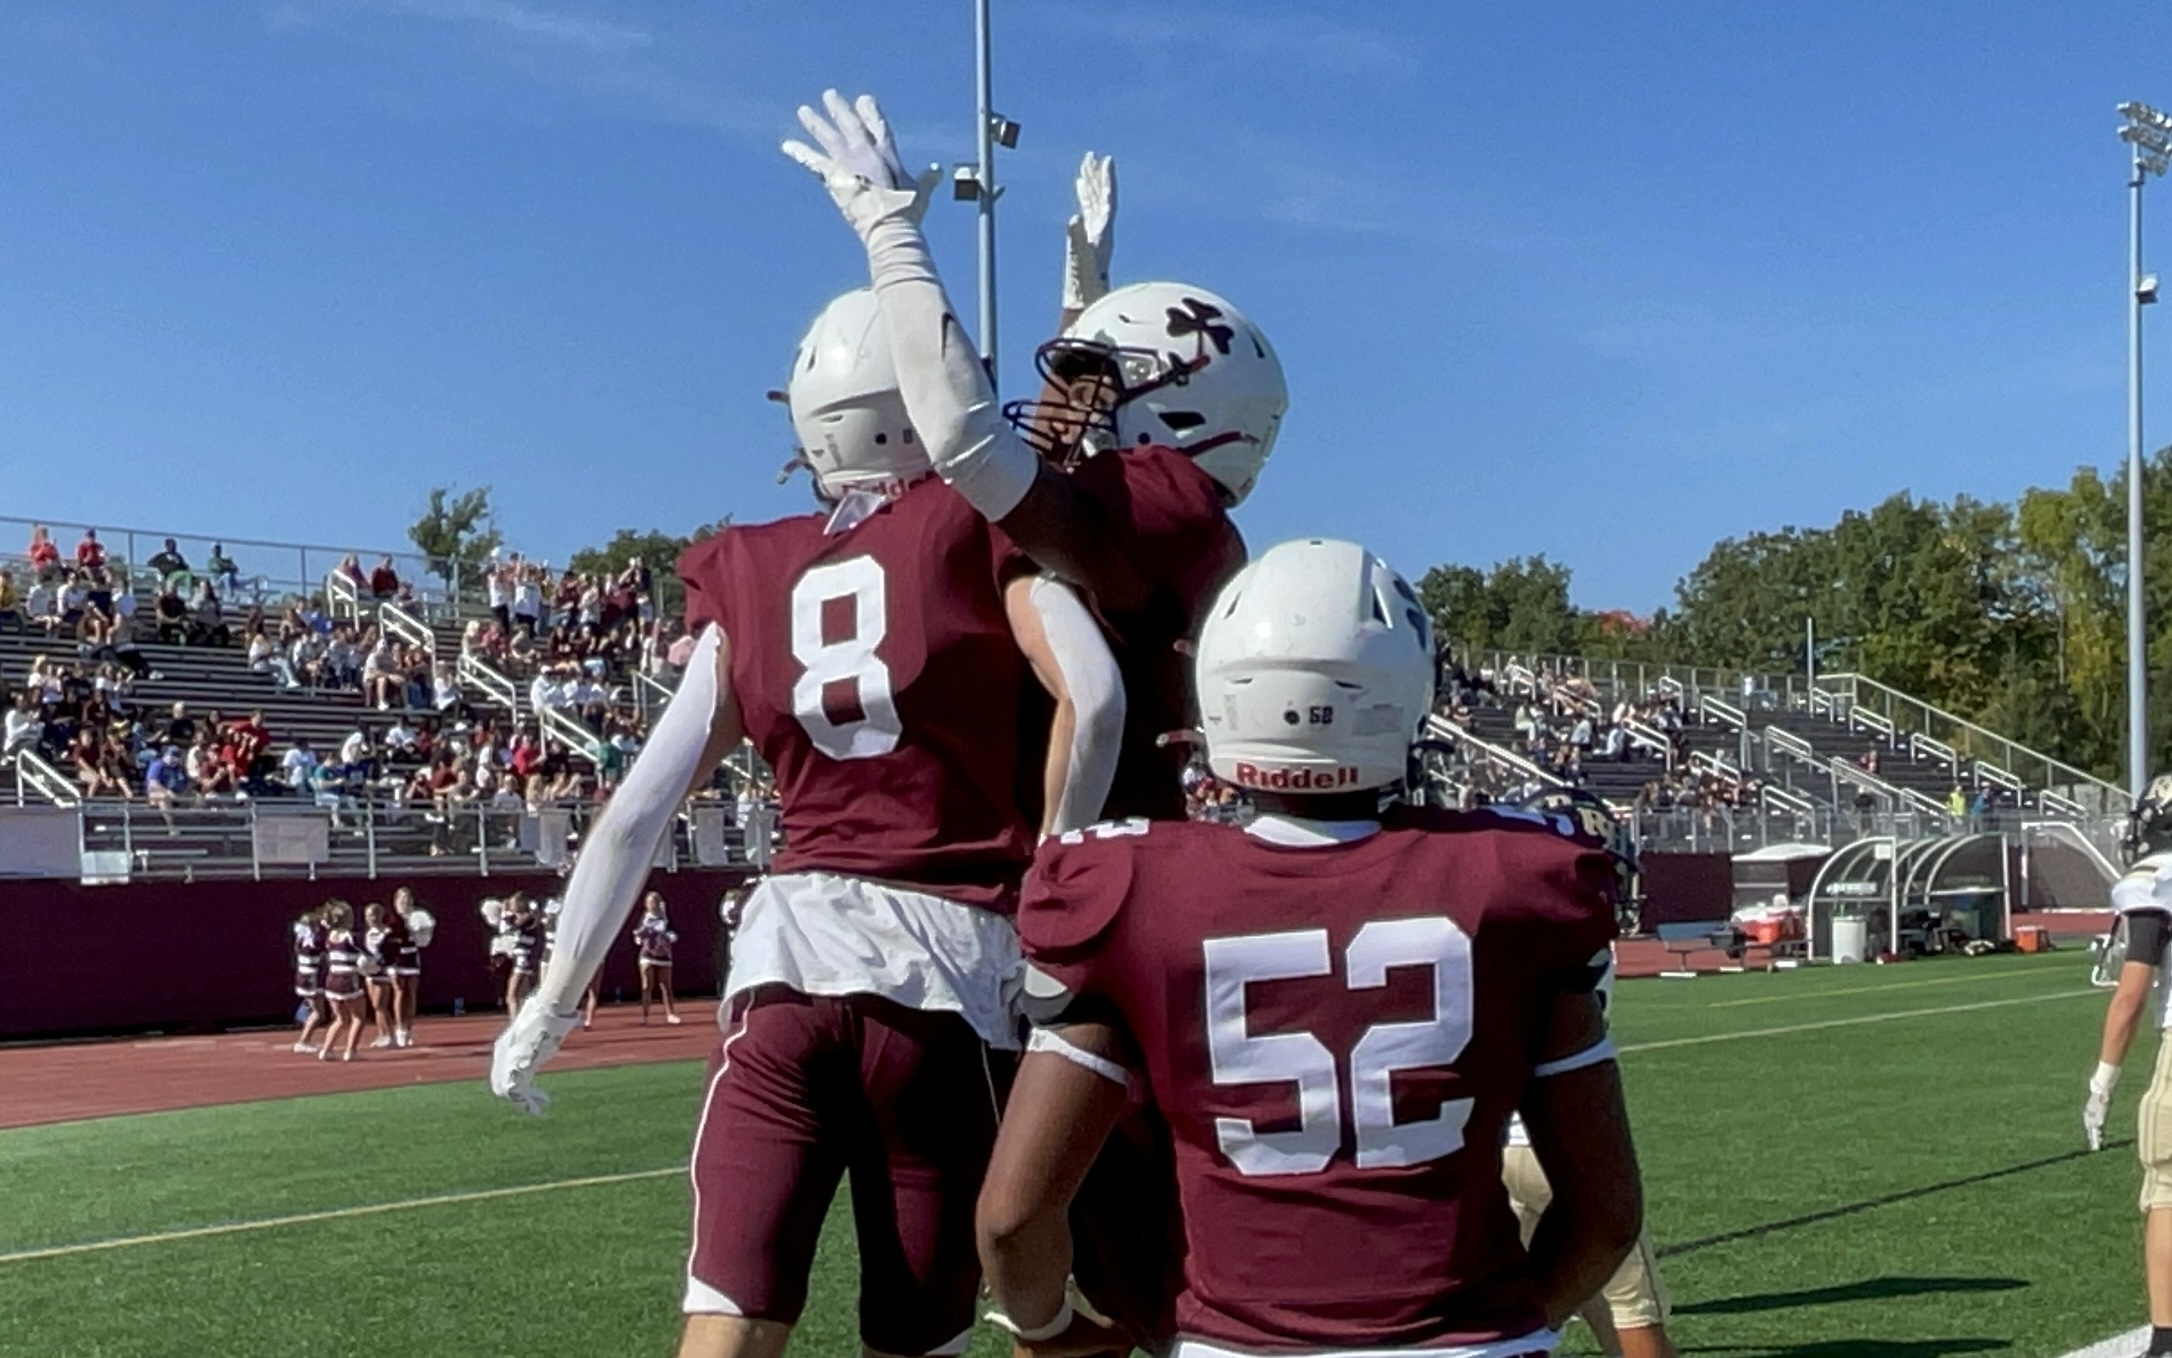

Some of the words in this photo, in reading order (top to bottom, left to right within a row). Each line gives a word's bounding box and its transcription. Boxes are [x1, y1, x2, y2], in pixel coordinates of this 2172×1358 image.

[792, 554, 903, 760] 8
[1236, 762, 1359, 789] Riddell
[1203, 916, 1476, 1176] 52
